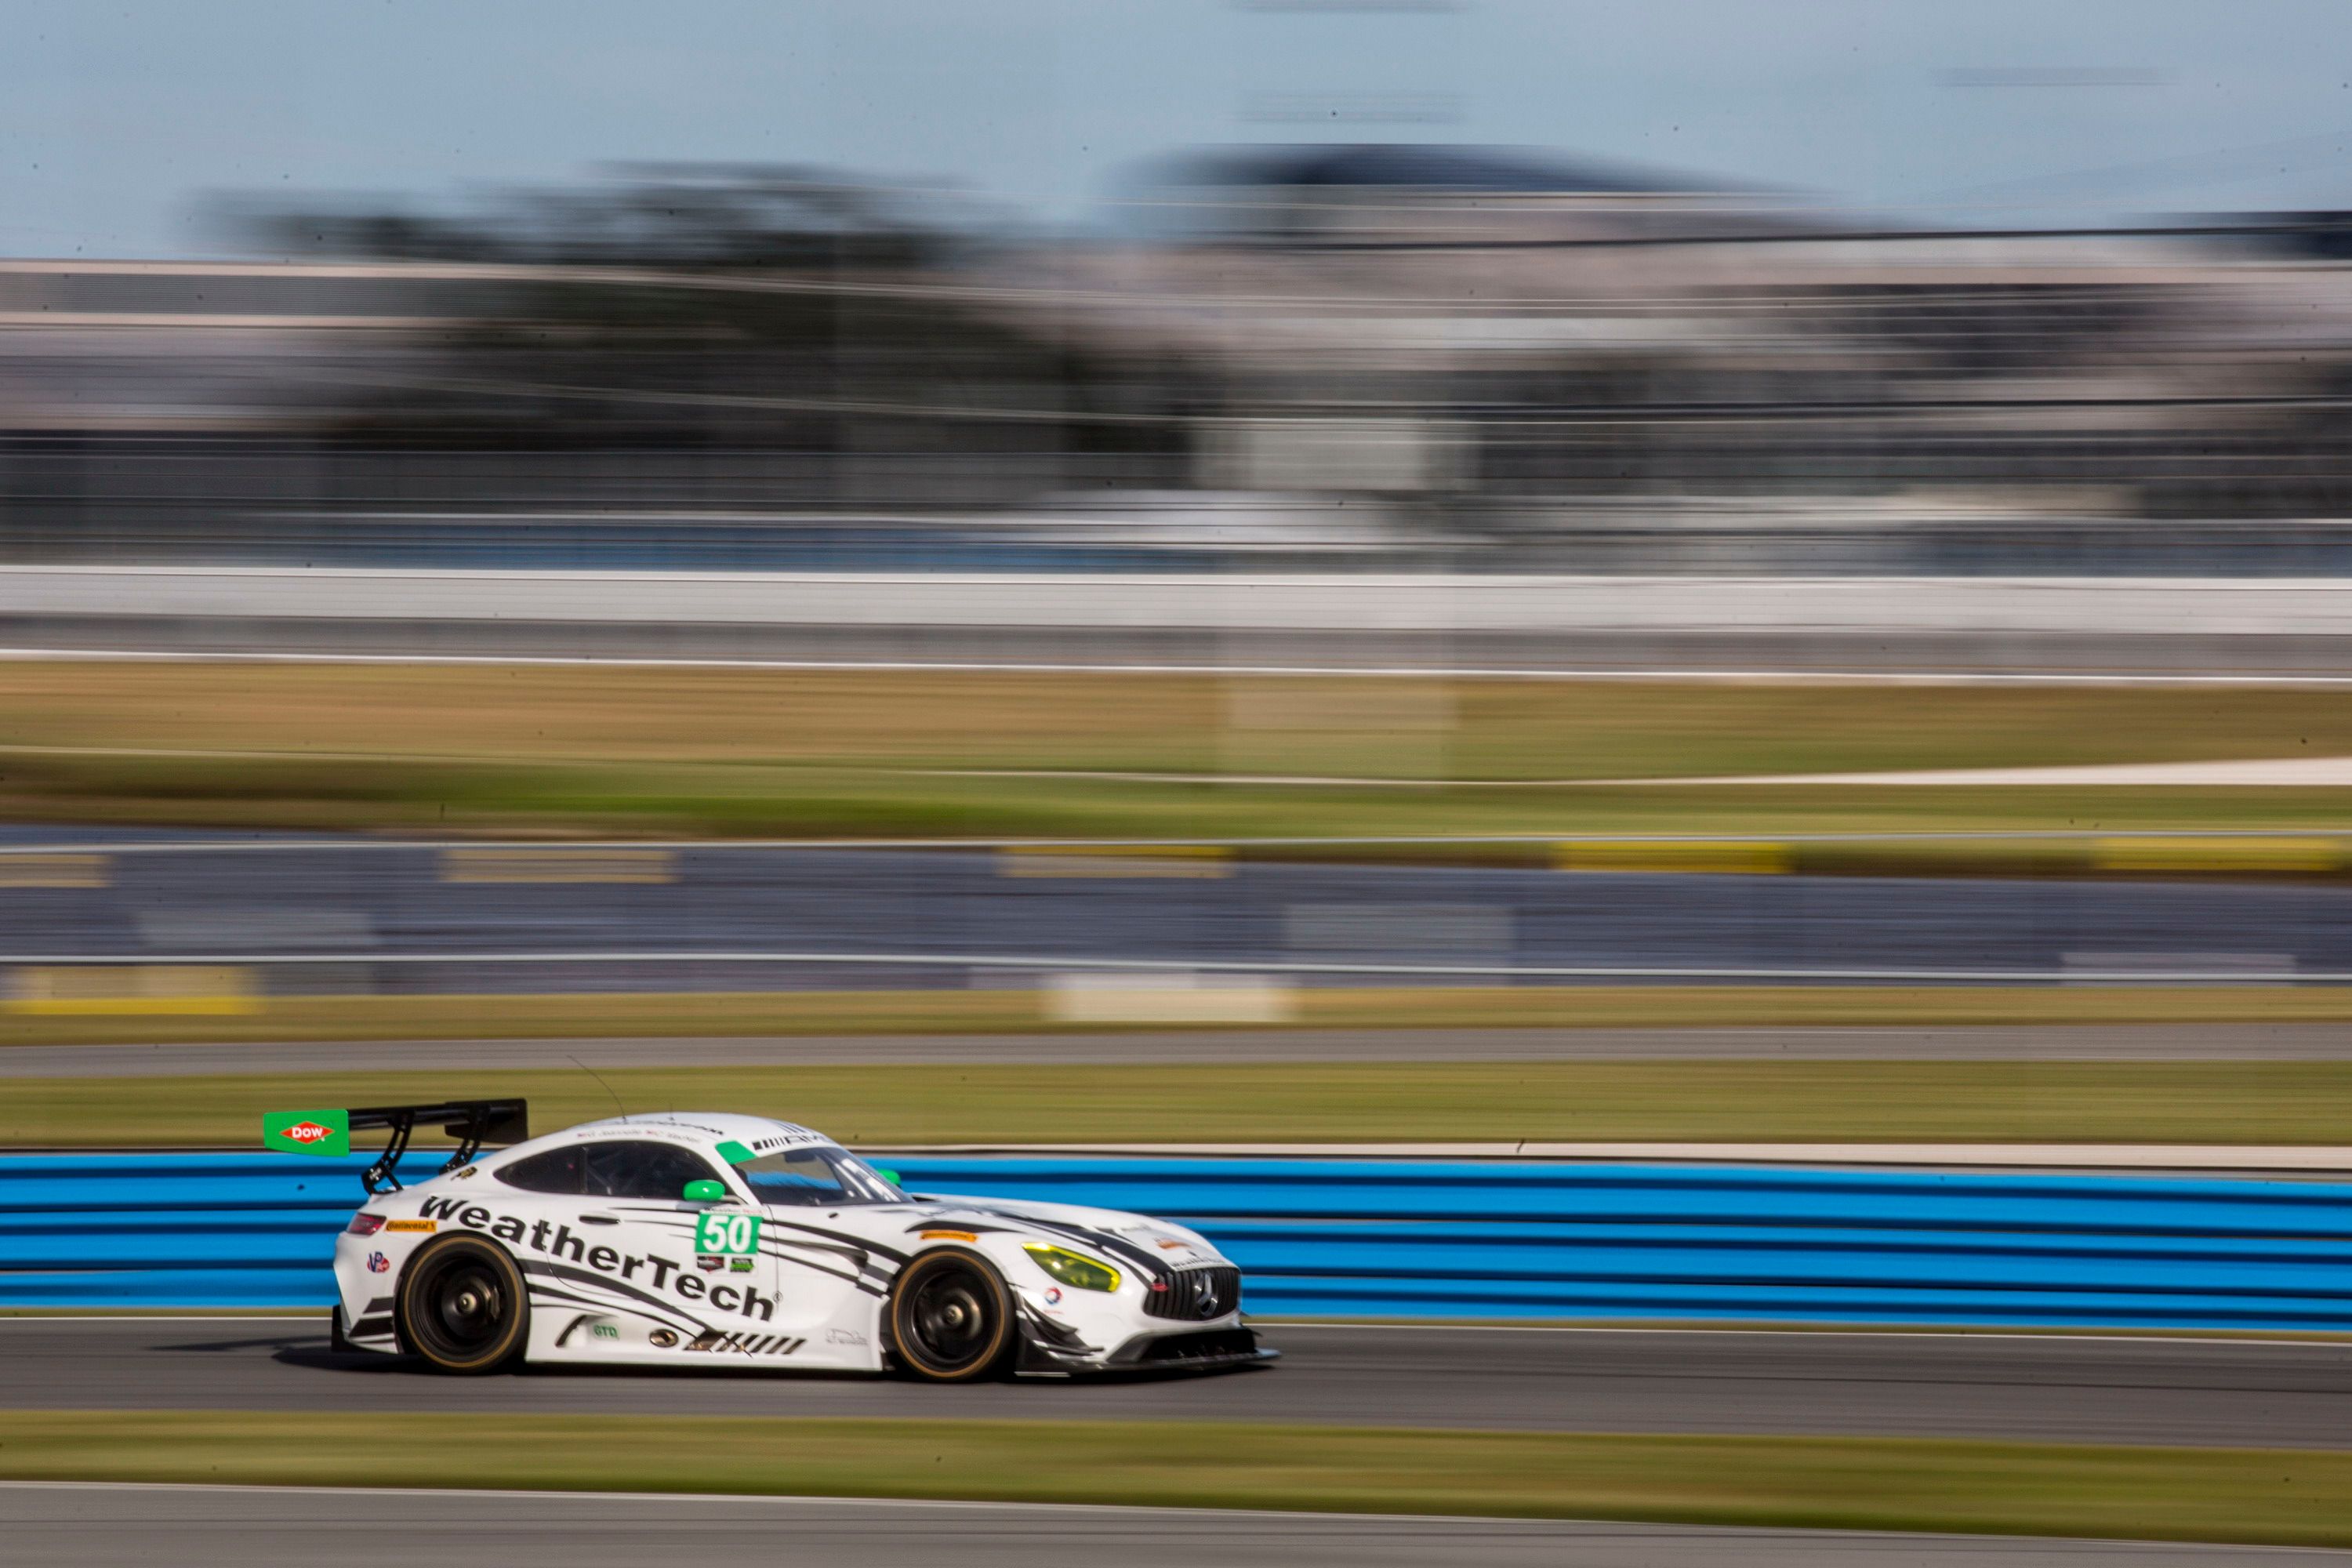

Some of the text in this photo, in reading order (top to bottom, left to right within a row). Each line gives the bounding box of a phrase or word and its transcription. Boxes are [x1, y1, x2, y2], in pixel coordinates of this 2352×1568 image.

[387, 1221, 428, 1231] Continental
[702, 1215, 752, 1253] 50
[368, 1251, 383, 1272] VP
[419, 1195, 775, 1322] WeatherTech
[593, 1325, 618, 1338] GTD
